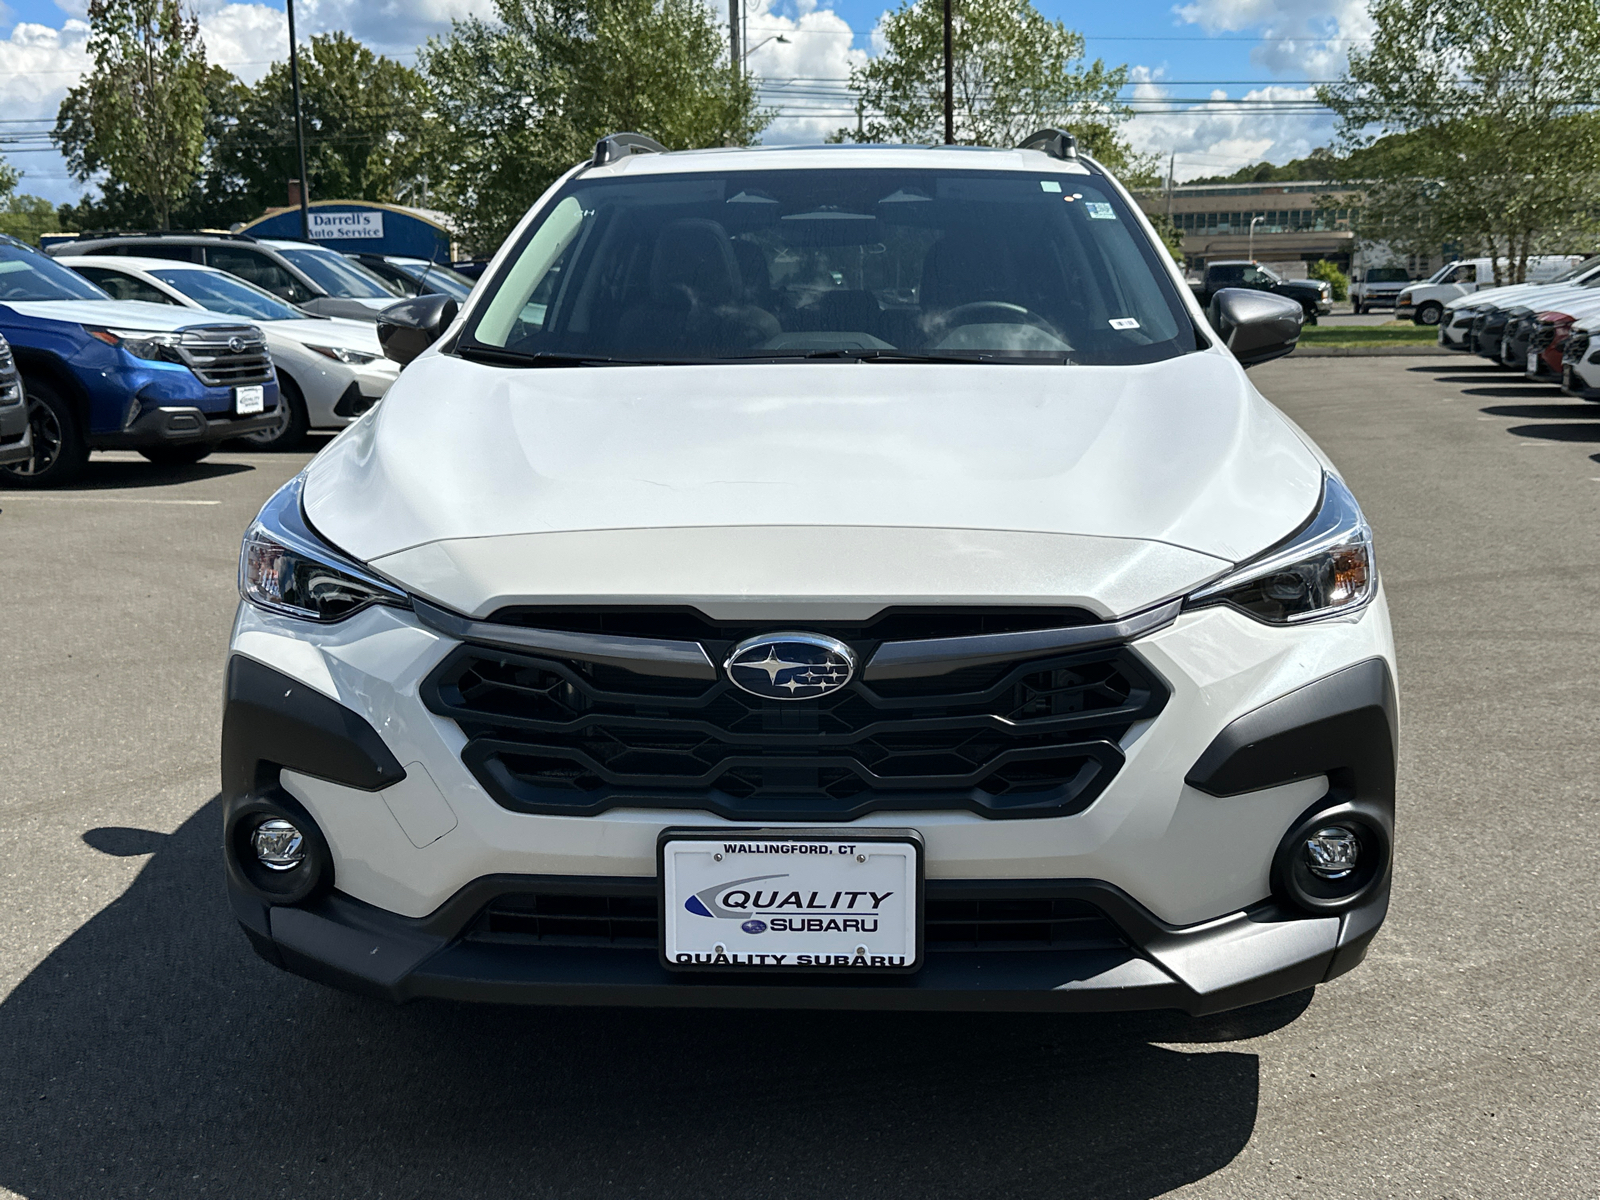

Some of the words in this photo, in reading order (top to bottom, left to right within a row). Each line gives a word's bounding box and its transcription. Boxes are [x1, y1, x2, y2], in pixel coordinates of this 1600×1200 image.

[314, 213, 371, 226] Darrell's
[338, 228, 380, 237] Service
[723, 844, 833, 855] WALLINGFORD,
[838, 845, 857, 855] CT
[722, 890, 894, 909] QUALITY
[770, 919, 878, 932] SUBARU
[675, 953, 787, 966] QUALITY
[796, 955, 906, 967] SUBARU
